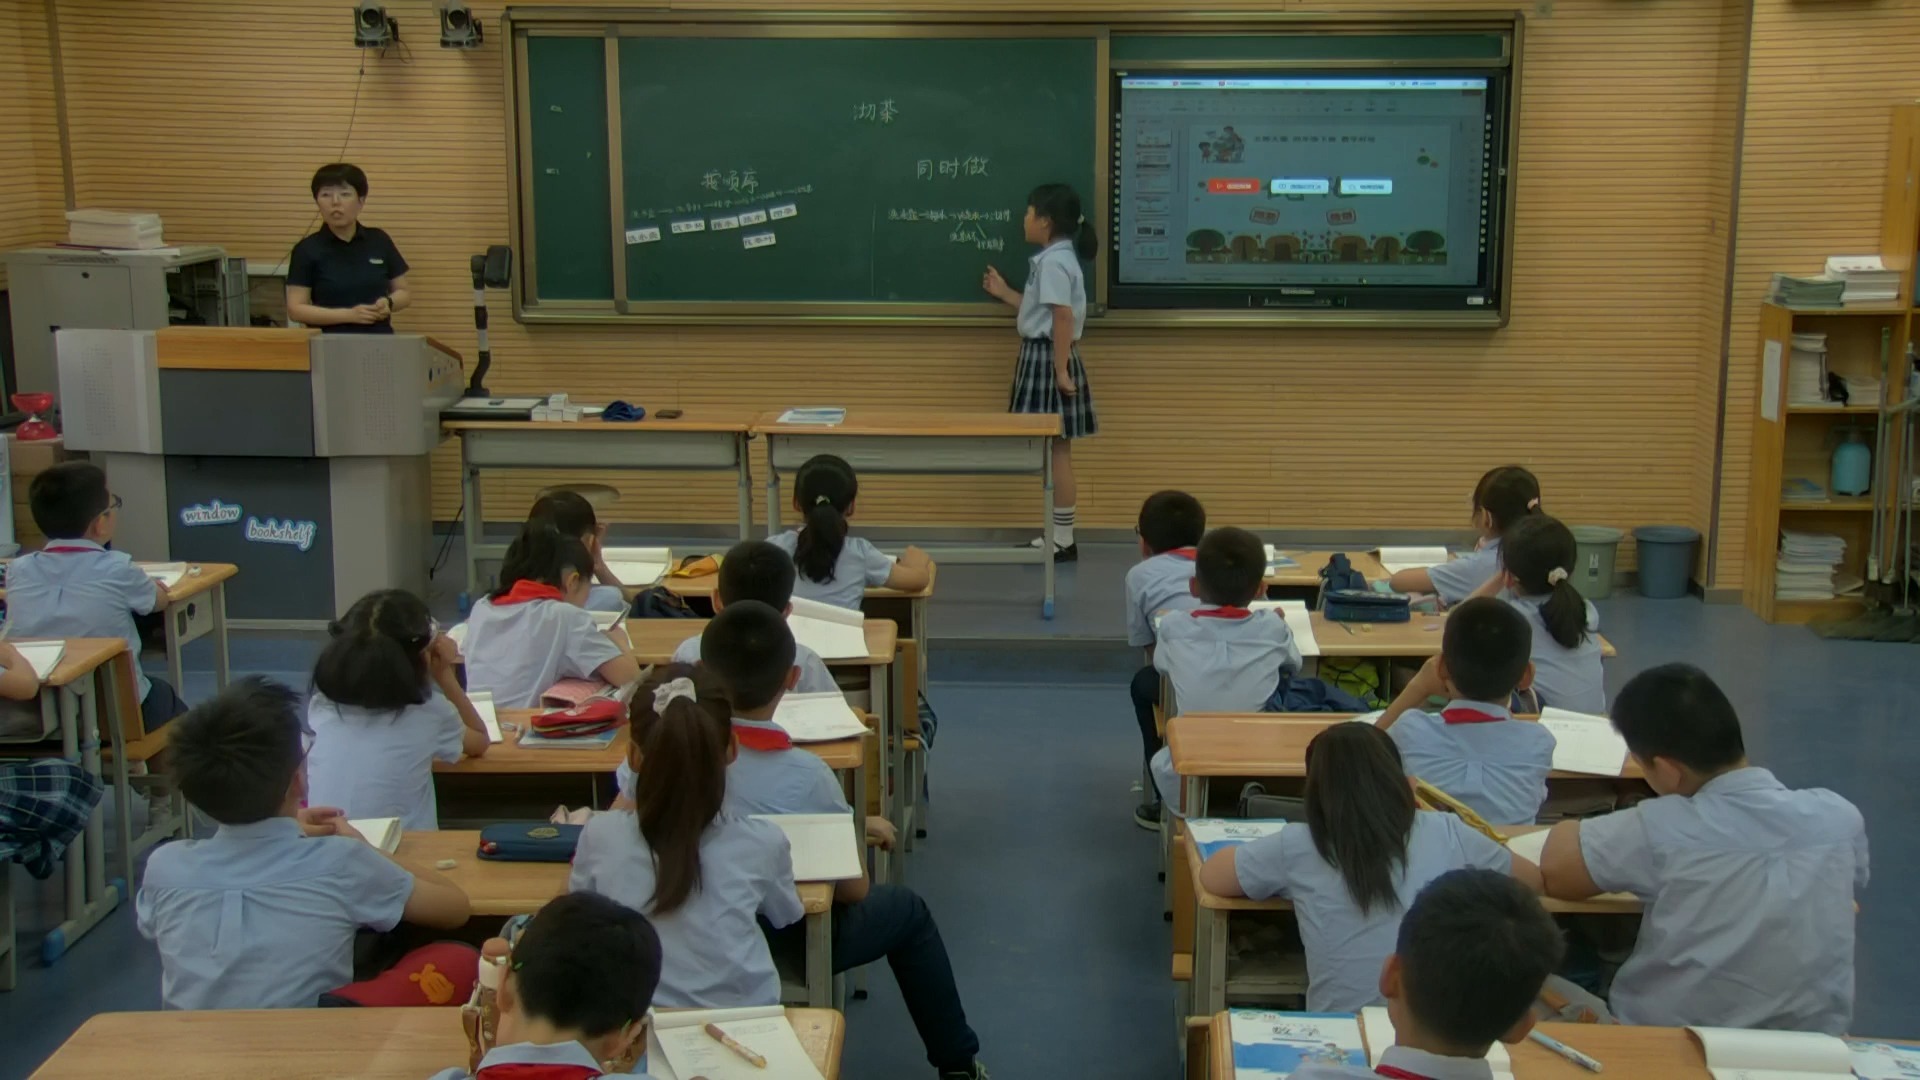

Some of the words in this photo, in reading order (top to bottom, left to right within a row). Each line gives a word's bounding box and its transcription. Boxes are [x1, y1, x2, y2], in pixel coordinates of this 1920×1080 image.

[917, 156, 989, 180] 同时做
[701, 169, 759, 194] 按顺序
[185, 503, 238, 521] window
[250, 522, 312, 542] bookshelf
